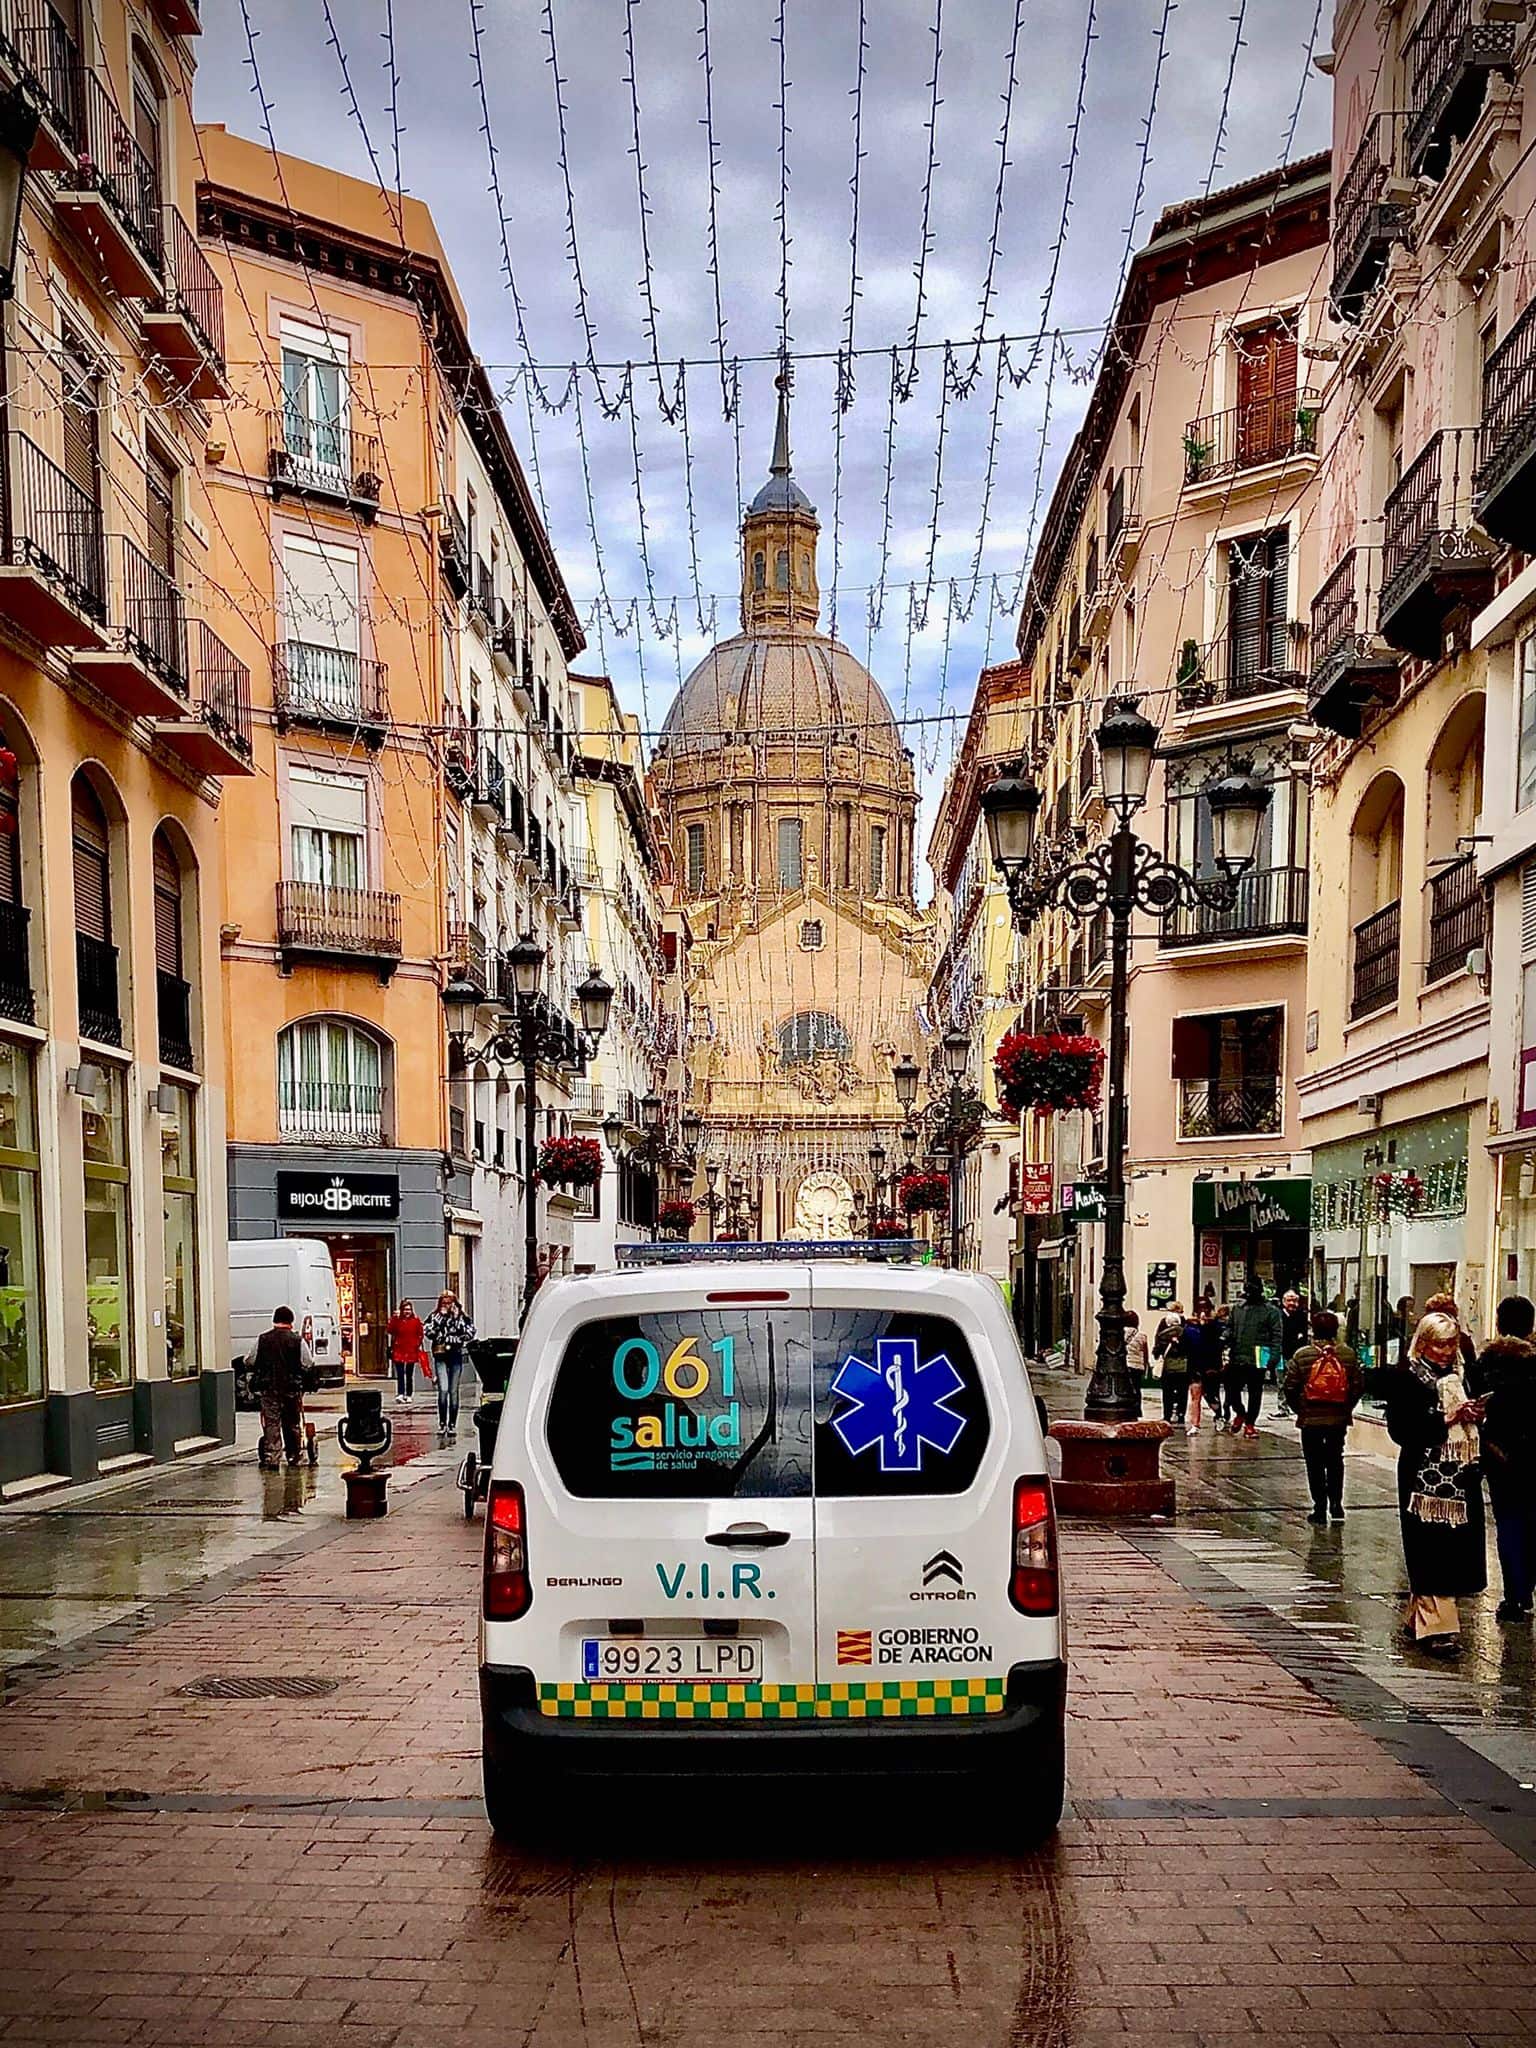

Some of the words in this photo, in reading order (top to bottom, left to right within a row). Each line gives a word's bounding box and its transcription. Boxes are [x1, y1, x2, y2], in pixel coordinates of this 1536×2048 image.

[290, 1192, 323, 1208] BIJOU
[612, 1336, 735, 1400] 061
[610, 1402, 740, 1449] salud
[655, 1449, 692, 1460] servicio
[656, 1460, 668, 1470] de
[671, 1459, 697, 1470] salud
[546, 1577, 623, 1588] BERLINGO
[655, 1563, 776, 1599] V.I.R.
[878, 1627, 979, 1646] GOBIERNO
[604, 1646, 682, 1674] 9923
[696, 1645, 754, 1673] LPD
[878, 1648, 902, 1664] DE
[909, 1646, 993, 1664] ARAGON
